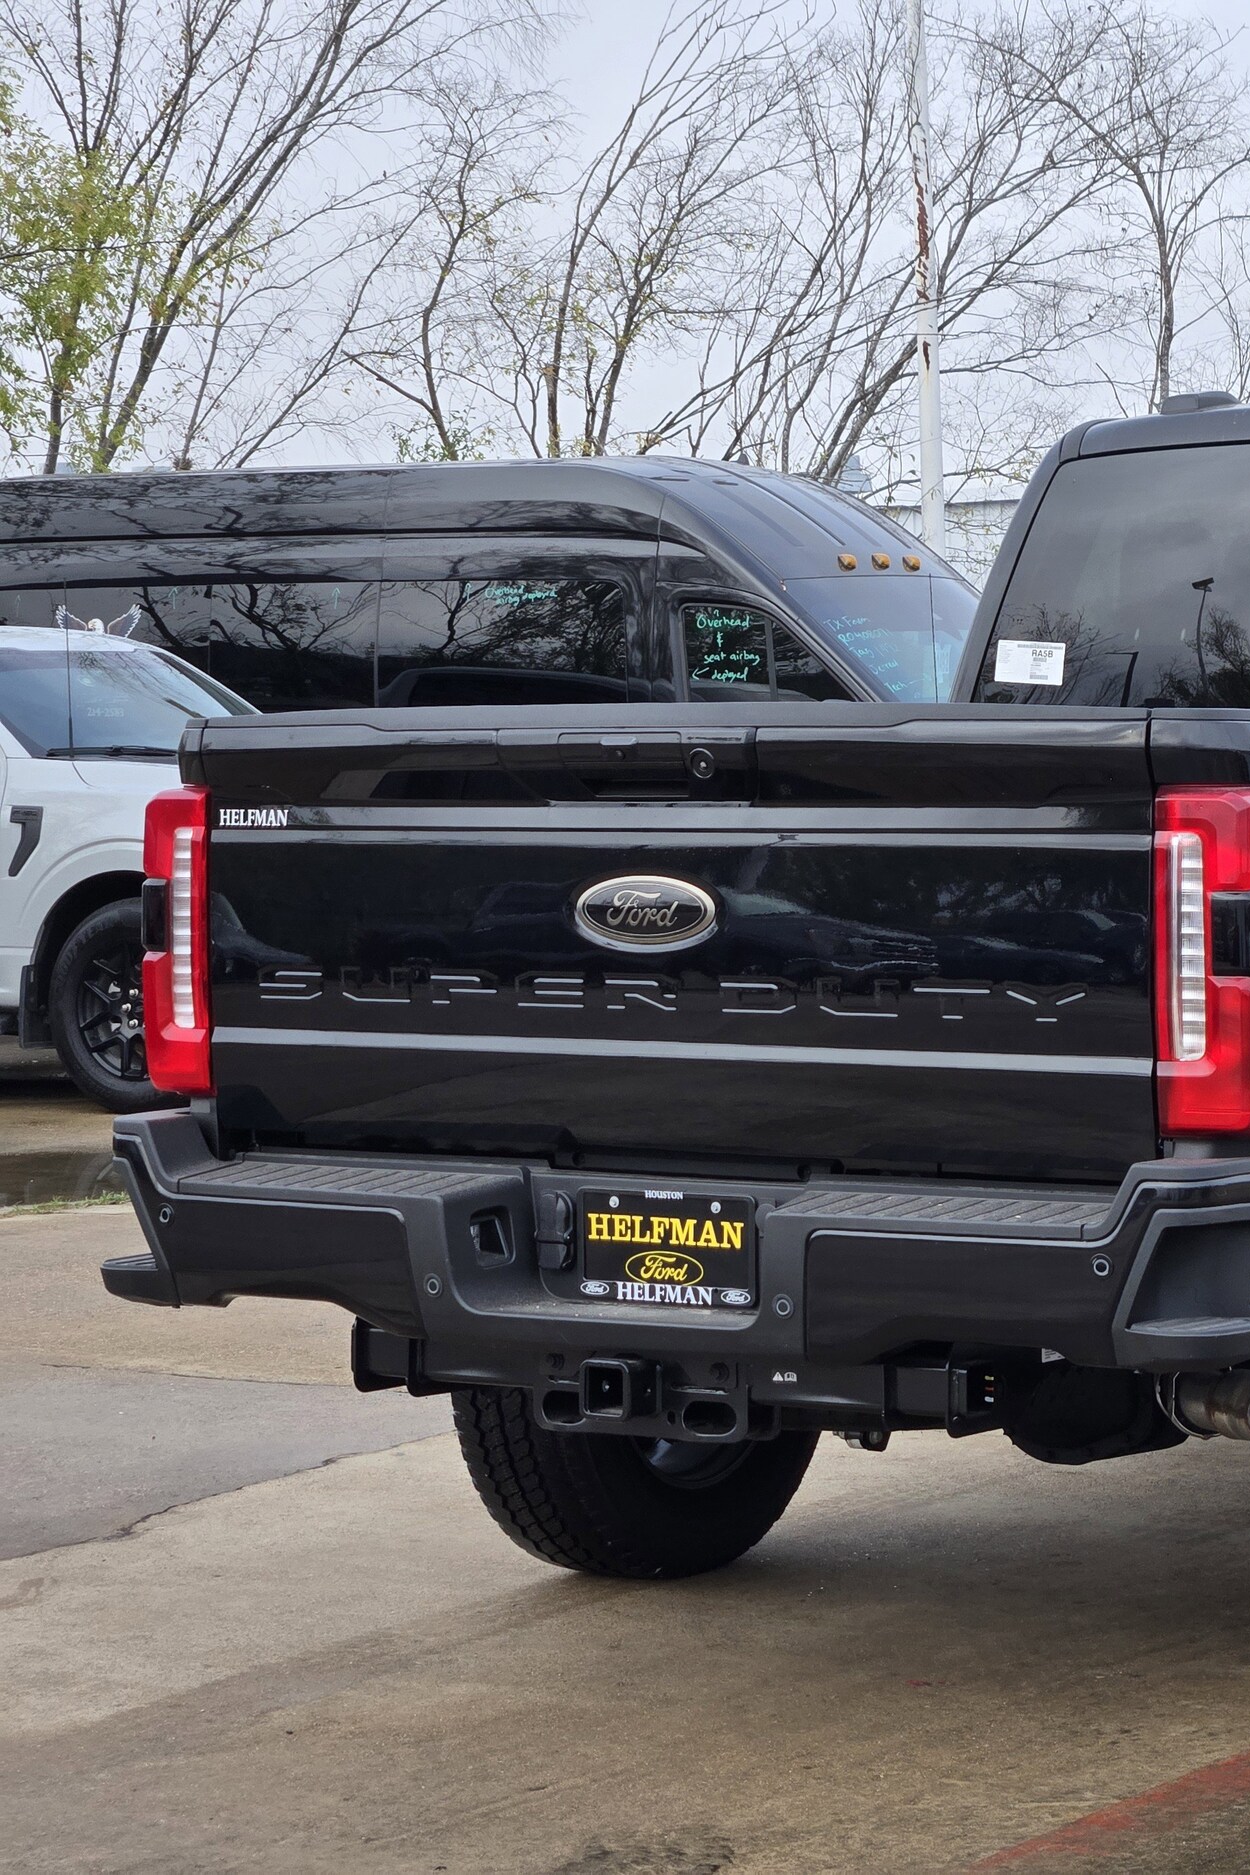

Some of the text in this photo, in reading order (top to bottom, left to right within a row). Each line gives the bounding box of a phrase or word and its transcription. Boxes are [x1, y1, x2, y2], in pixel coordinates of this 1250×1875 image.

[697, 614, 750, 628] Overhead
[704, 650, 760, 665] seat airbag
[711, 667, 748, 683] deployed
[219, 808, 289, 827] HELFMAN
[606, 888, 678, 928] Ford
[258, 964, 1088, 1022] SUPER DUTY
[644, 1190, 684, 1200] HOUSTON
[588, 1213, 744, 1249] HELFMAN
[640, 1254, 688, 1282] Ford
[617, 1281, 713, 1306] HELFMAN
